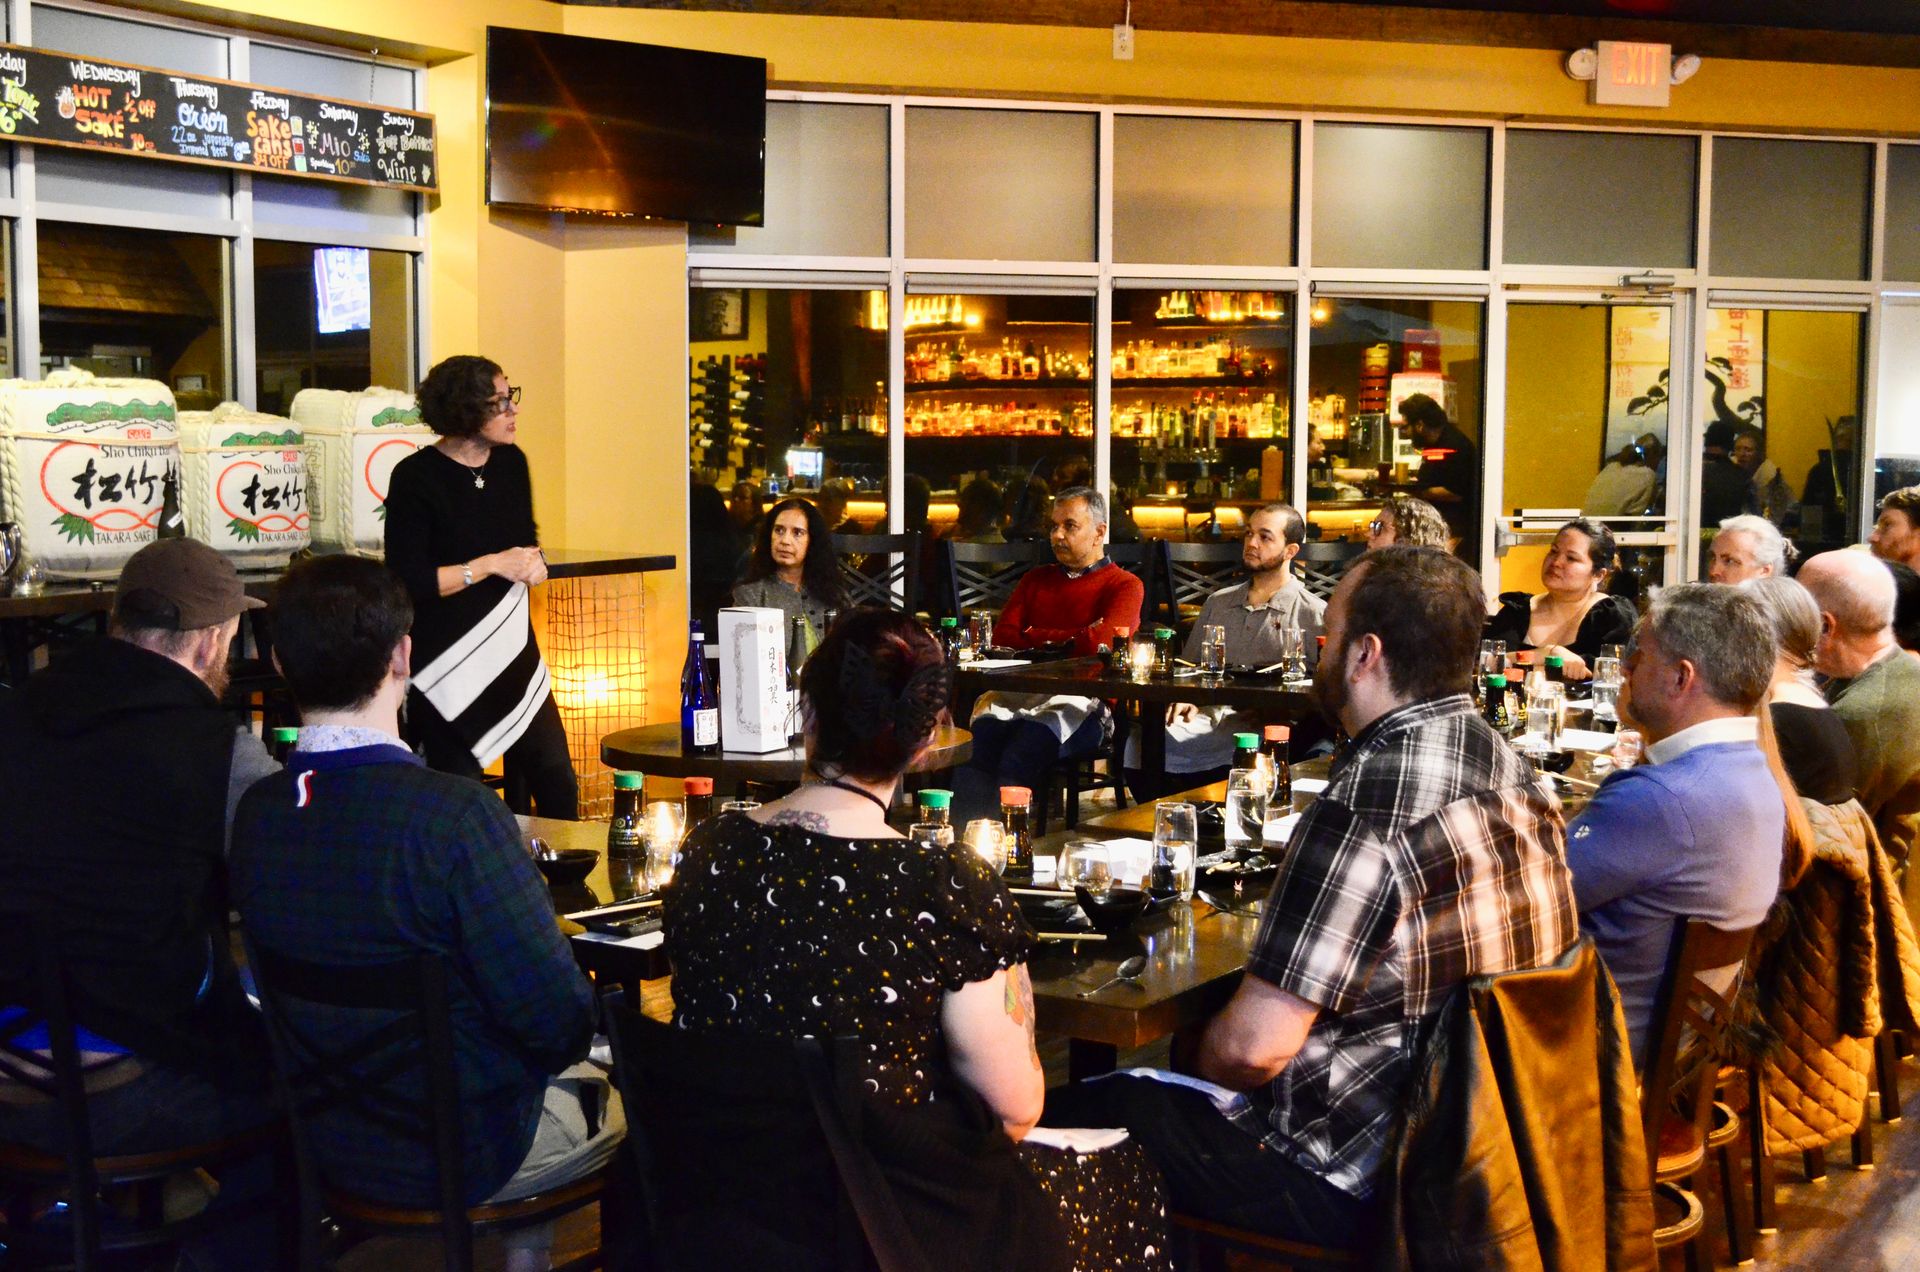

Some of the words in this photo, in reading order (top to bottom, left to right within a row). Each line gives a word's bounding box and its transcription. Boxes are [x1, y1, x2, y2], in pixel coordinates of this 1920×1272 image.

[1612, 44, 1662, 86] EXIT
[72, 84, 112, 110] HOT
[178, 102, 228, 135] Orion
[246, 111, 293, 139] Sake
[269, 155, 289, 169] OFF
[377, 158, 417, 183] Wine
[127, 429, 151, 439] SAKE
[101, 445, 125, 458] Sho
[95, 531, 132, 544] TAKARA
